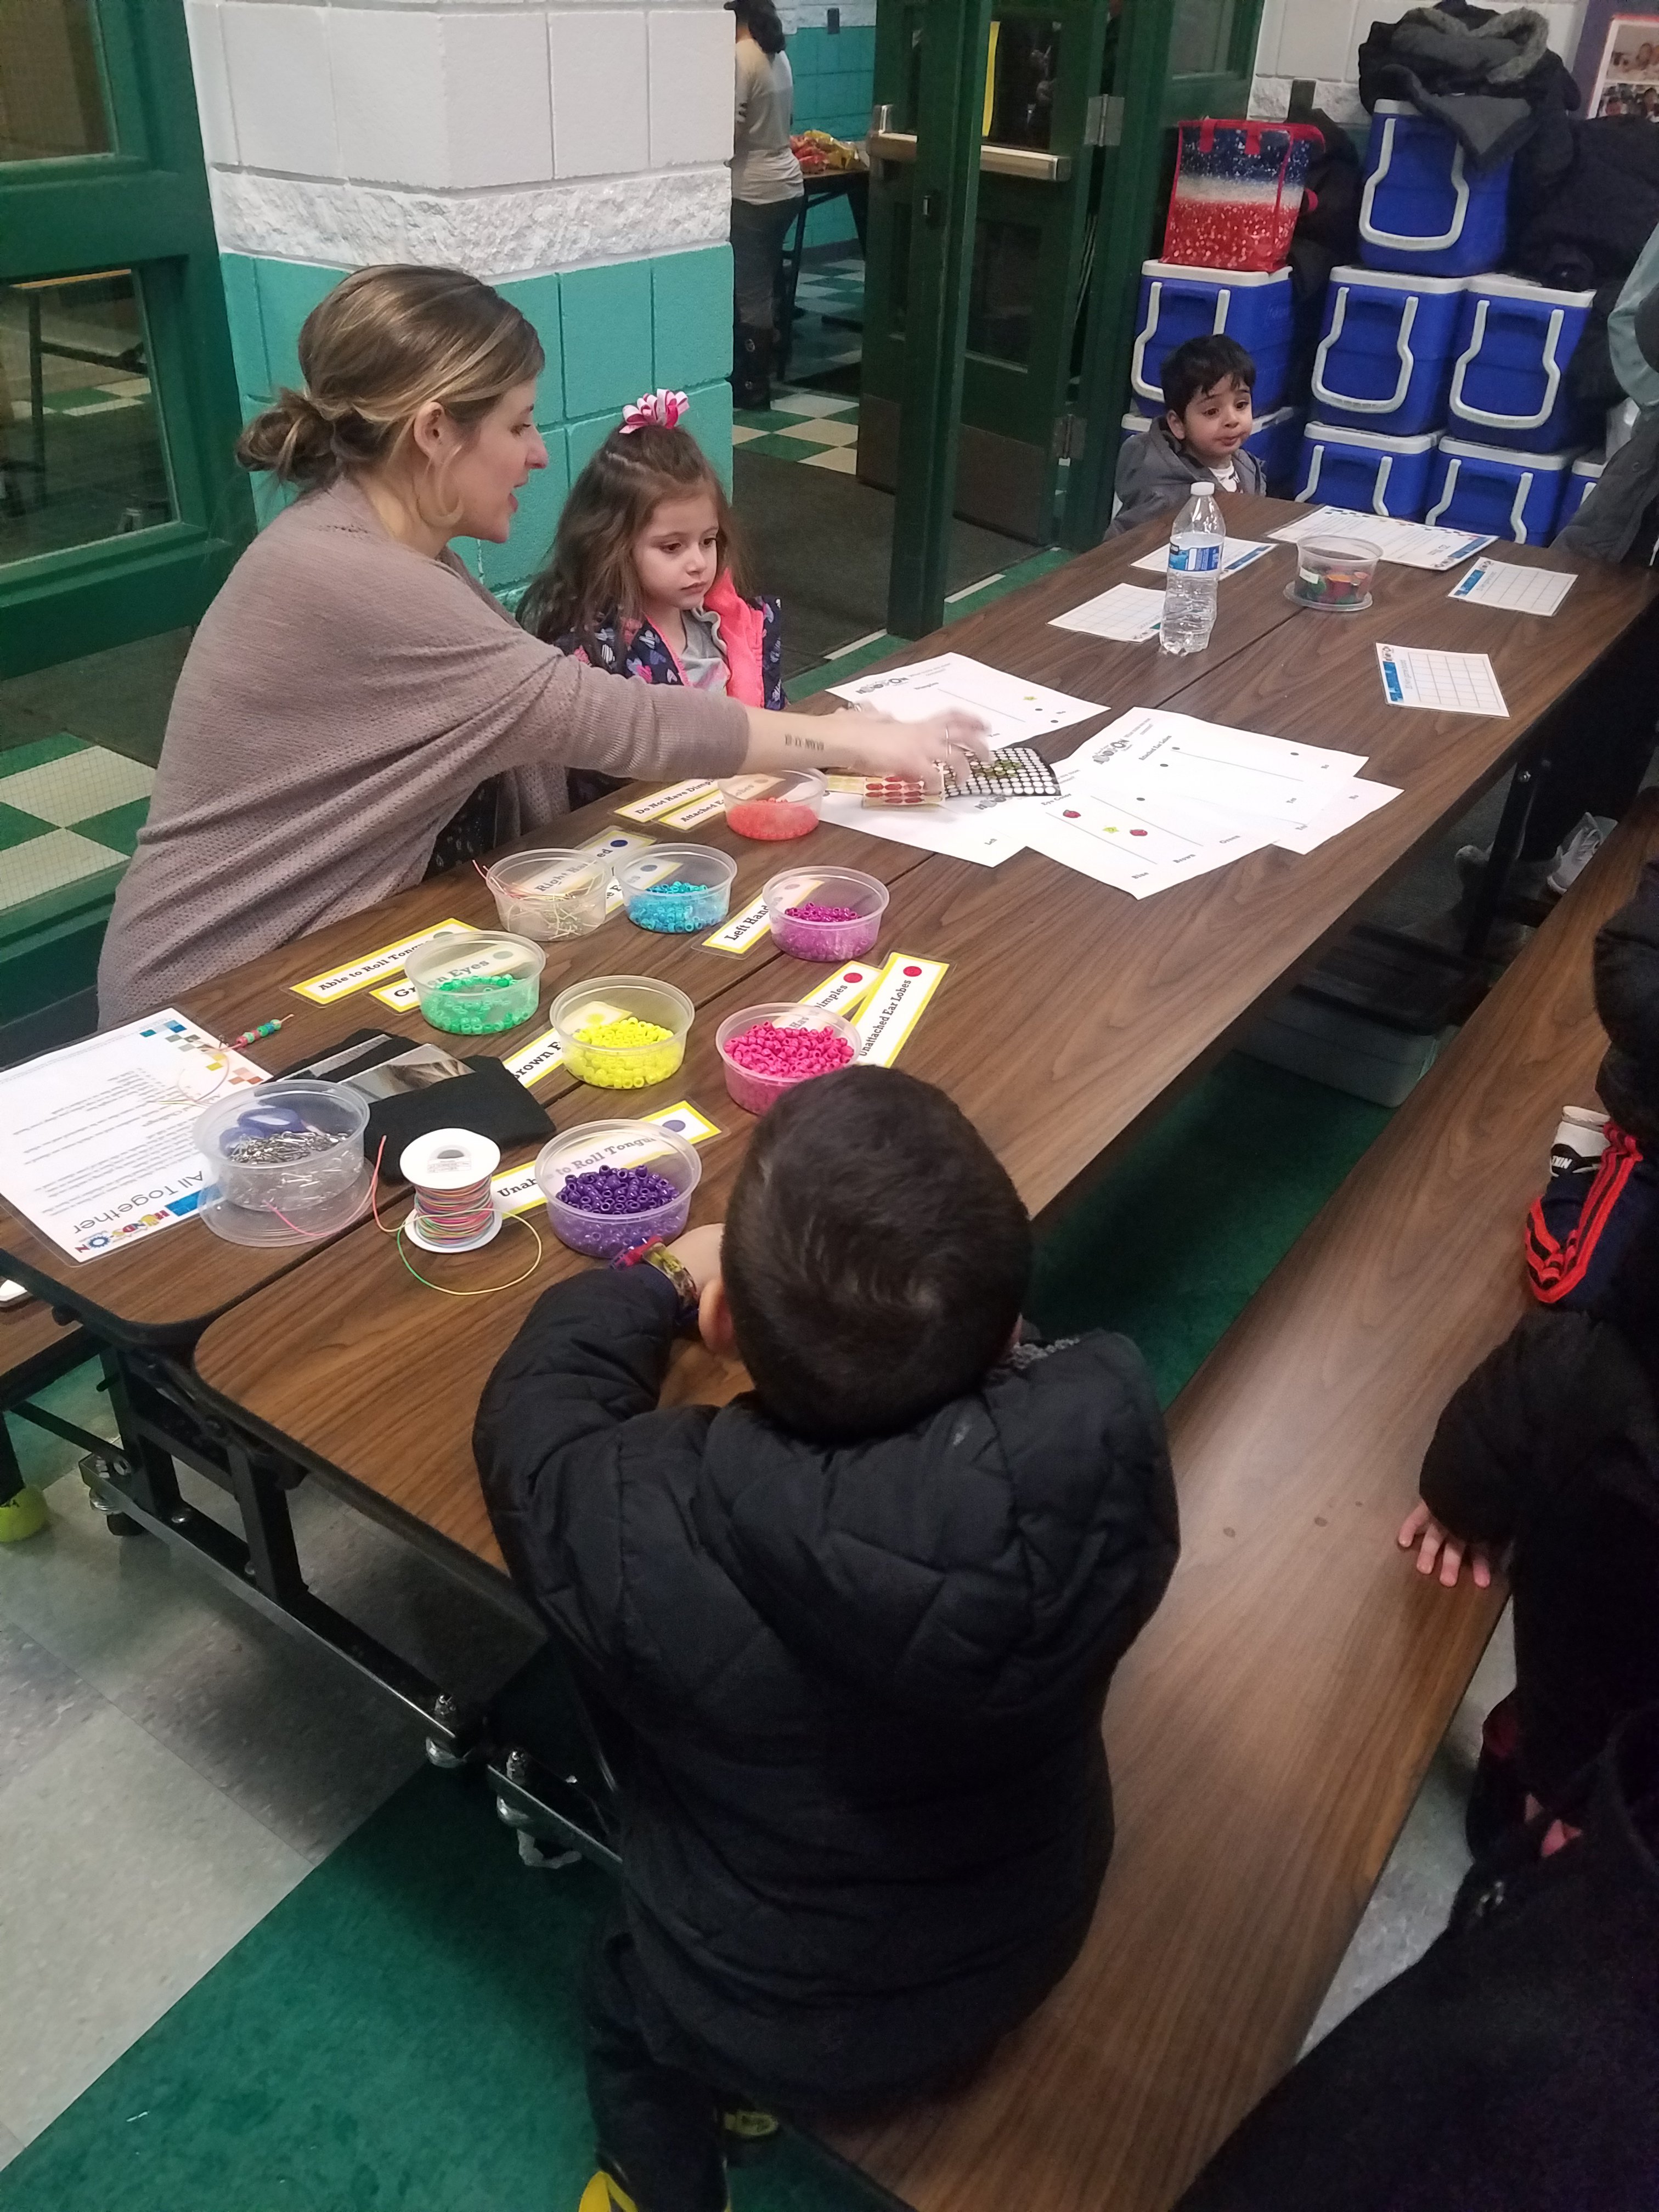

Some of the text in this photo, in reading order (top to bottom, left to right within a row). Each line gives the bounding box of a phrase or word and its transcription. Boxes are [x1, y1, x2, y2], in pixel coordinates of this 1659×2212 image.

[635, 806, 650, 815] Do
[648, 799, 666, 809] Not
[665, 791, 687, 802] Have
[680, 802, 717, 822] Attached
[724, 925, 751, 940] Left
[318, 977, 349, 990] Able
[361, 959, 389, 973] Roll
[448, 959, 490, 978] Eyes
[859, 979, 912, 1057] Unattached Ear Lobes
[555, 1166, 572, 1176] to
[571, 1152, 606, 1170] Roll
[178, 1170, 203, 1188] All
[73, 1185, 178, 1234] Together
